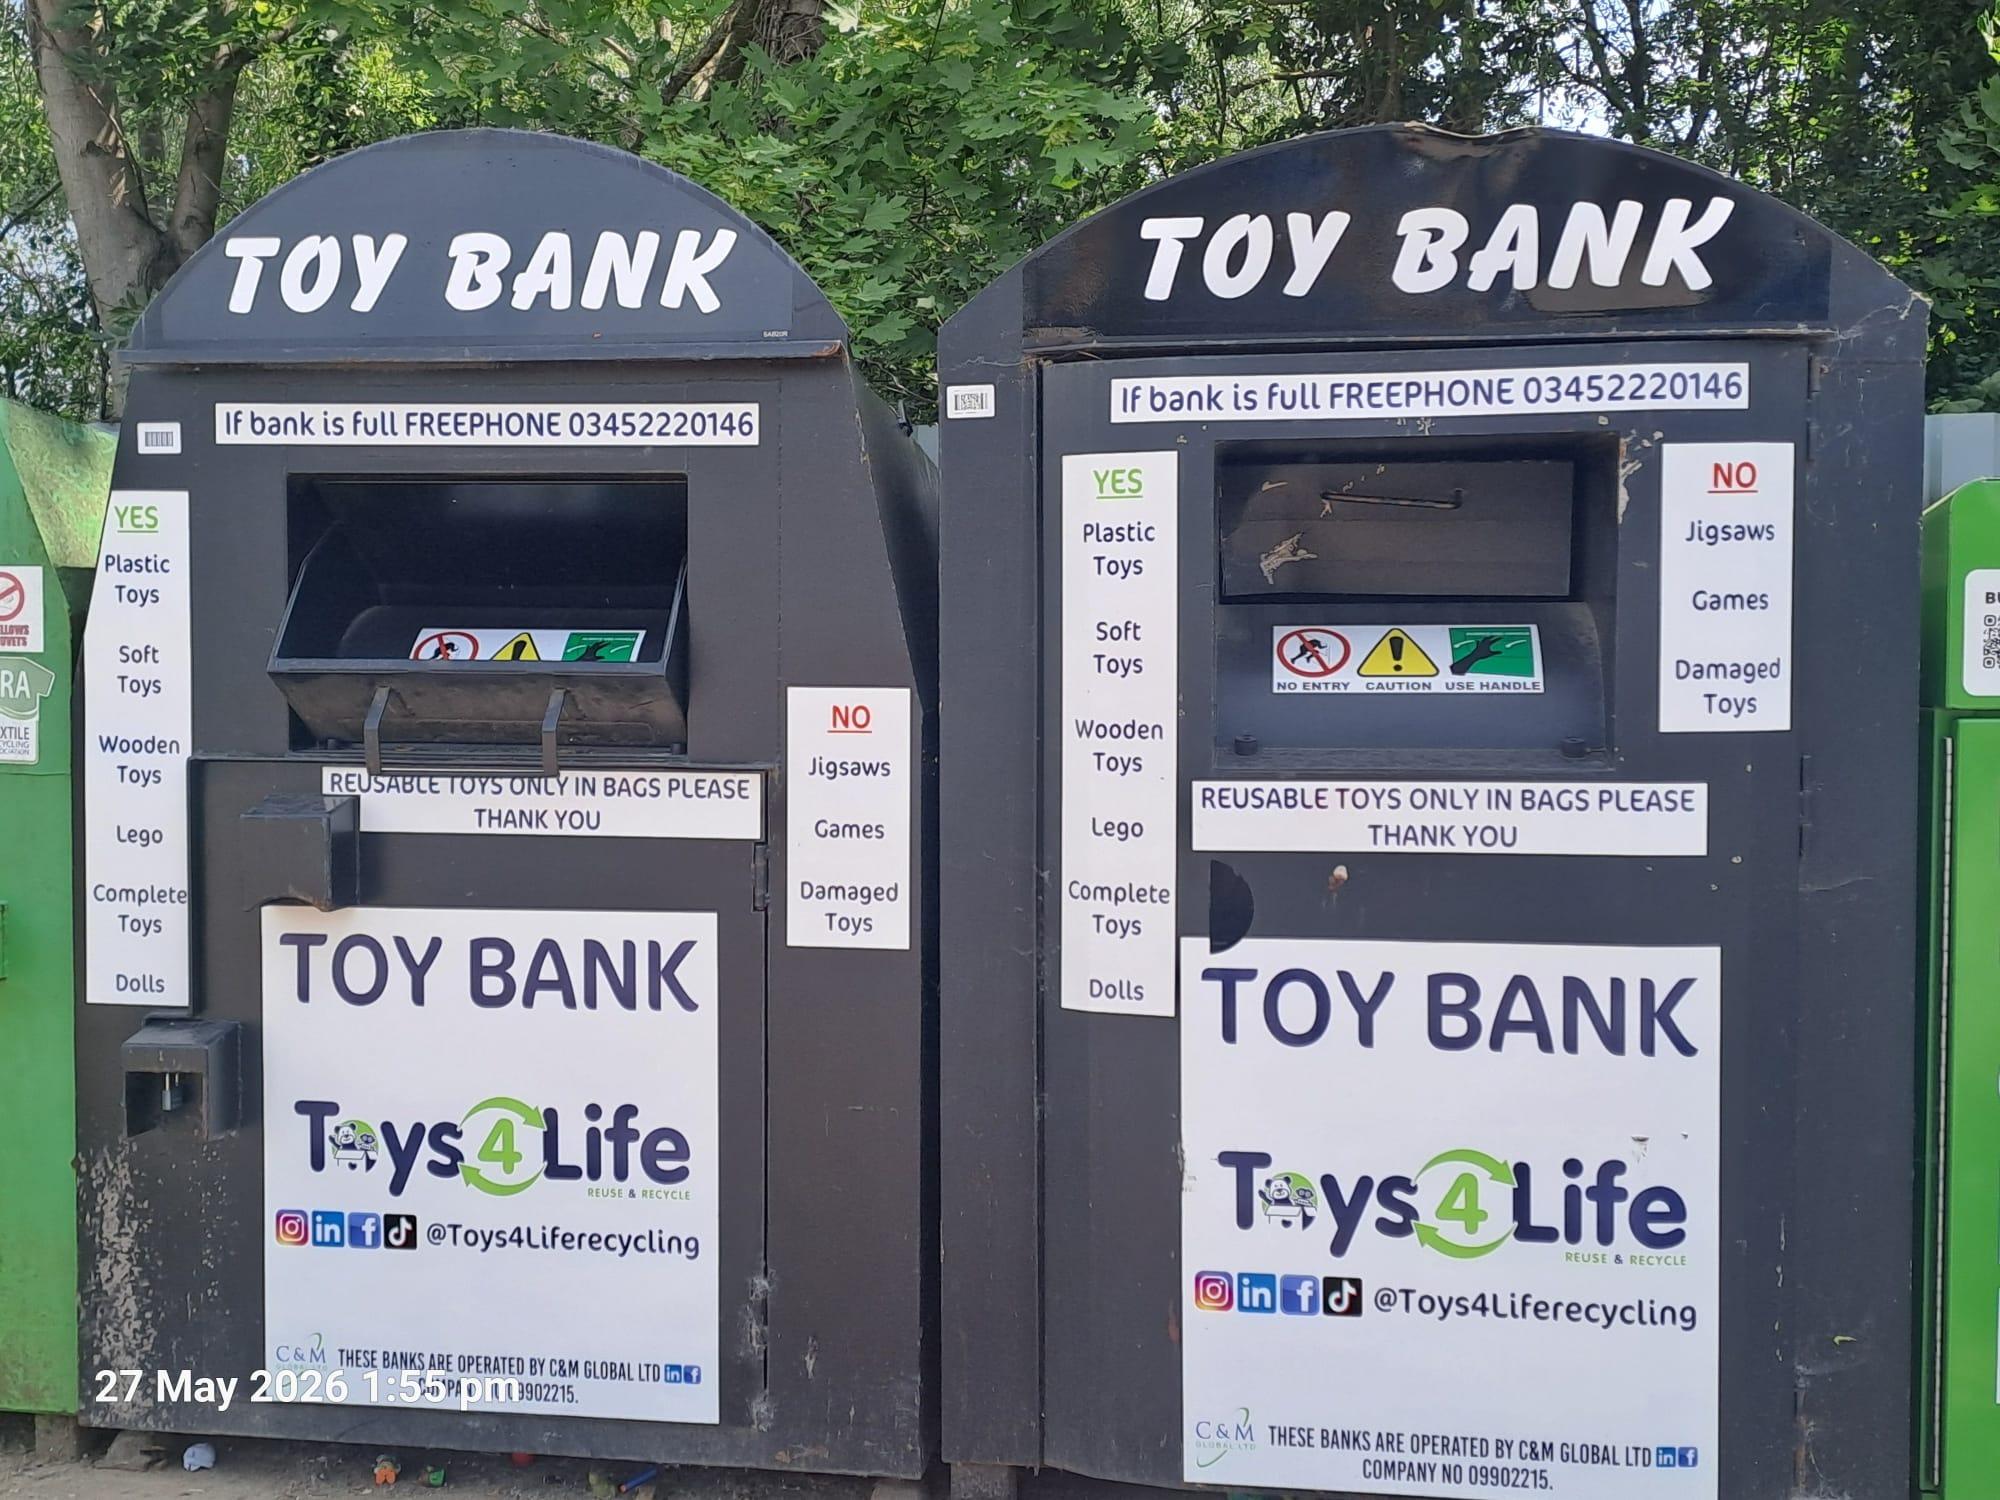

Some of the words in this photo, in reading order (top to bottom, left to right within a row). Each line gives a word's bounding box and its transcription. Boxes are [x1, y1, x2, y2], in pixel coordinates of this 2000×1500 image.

[1141, 211, 1350, 301] TOY
[1393, 197, 1735, 293] BANK
[225, 233, 408, 314] TOY
[445, 229, 738, 314] BANK
[1123, 386, 1141, 413] If
[1150, 384, 1223, 412] bank
[1234, 383, 1257, 410] is
[1268, 382, 1320, 410] full
[1330, 378, 1514, 409] FREEPHONE
[1524, 372, 1742, 404] 03452220146
[226, 410, 242, 435] If
[251, 411, 315, 435] bank
[323, 411, 344, 436] is
[353, 411, 398, 436] full
[406, 412, 561, 436] FREEPHONE
[569, 412, 753, 436] 03452220146
[1093, 469, 1142, 494] YES
[1714, 462, 1756, 488] NO
[114, 506, 158, 529] YES
[1084, 521, 1155, 542] Plastic
[1686, 520, 1774, 546] Jigsaws
[105, 554, 169, 573] Plastic
[1093, 556, 1143, 579] Toys
[115, 585, 159, 607] Toys
[1693, 590, 1768, 610] Games
[1097, 621, 1141, 641] Soft
[119, 645, 159, 663] Soft
[1093, 655, 1142, 678] Toys
[1676, 658, 1780, 684] Damaged
[117, 676, 161, 697] Toys
[1277, 682, 1297, 690] NO
[1303, 682, 1350, 690] ENTRY
[1366, 682, 1431, 690] CAUTION
[1446, 682, 1474, 690] USE
[1480, 682, 1540, 690] HANDLE
[833, 705, 870, 729] NO
[1704, 694, 1756, 718] Toys
[1075, 720, 1163, 739] Wooden
[99, 735, 179, 754] Wooden
[809, 756, 890, 780] Jigsaws
[1093, 752, 1142, 776] Toys
[117, 766, 161, 787] Toys
[330, 773, 440, 794] REUSABLE
[575, 777, 596, 796] IN
[603, 777, 661, 799] BAGS
[668, 778, 750, 800] PLEASE
[1202, 788, 1328, 809] REUSABLE
[1335, 788, 1401, 809] TOYS
[1410, 788, 1479, 810] ONLY
[1488, 789, 1511, 810] IN
[1521, 789, 1589, 811] BAGS
[1599, 790, 1694, 812] PLEASE
[474, 809, 548, 829] THANK
[555, 810, 600, 830] YOU
[815, 819, 884, 839] Games
[1092, 817, 1143, 841] Lego
[117, 825, 163, 847] Lego
[1368, 825, 1455, 846] THANK
[1463, 825, 1517, 847] YOU
[93, 884, 188, 907] Complete
[801, 881, 898, 905] Damaged
[1069, 880, 1170, 906] Complete
[118, 915, 162, 937] Toys
[825, 913, 872, 936] Toys
[1092, 914, 1141, 939] Toys
[116, 974, 164, 993] Dolls
[280, 933, 442, 1006] TOY
[470, 937, 699, 1012] BANK
[1090, 979, 1143, 1001] Dolls
[1201, 968, 1395, 1048] TOY
[1427, 972, 1698, 1057] BANK
[588, 1188, 623, 1198] REUSE
[628, 1189, 636, 1198] &
[642, 1189, 690, 1200] RECYCLE
[427, 1223, 699, 1260] @Toys4Liferecycling
[1565, 1252, 1607, 1264] REUSE
[1614, 1254, 1623, 1264] &
[1630, 1255, 1686, 1266] RECYCLE
[1374, 1288, 1696, 1331] @Toys4Liferecycling
[338, 1349, 377, 1368] THESE
[383, 1351, 424, 1370] BANKS
[429, 1354, 452, 1372] ARE
[458, 1355, 524, 1375] OPERATED
[530, 1357, 545, 1376] BY
[550, 1359, 579, 1378] C&M
[584, 1361, 634, 1381] GLOBAL
[639, 1363, 660, 1382] LTD
[1269, 1426, 1314, 1448] THESE
[1321, 1429, 1370, 1451] BANKS
[1376, 1432, 1404, 1453] ARE
[1411, 1434, 1489, 1457] OPERATED
[1496, 1439, 1513, 1459] BY
[1519, 1440, 1553, 1461] C&M
[1561, 1443, 1620, 1465] GLOBAL
[1626, 1446, 1651, 1467] LTD
[1363, 1459, 1436, 1482] COMPANY
[1442, 1464, 1462, 1484] NO
[1469, 1465, 1553, 1490] 09902215.
